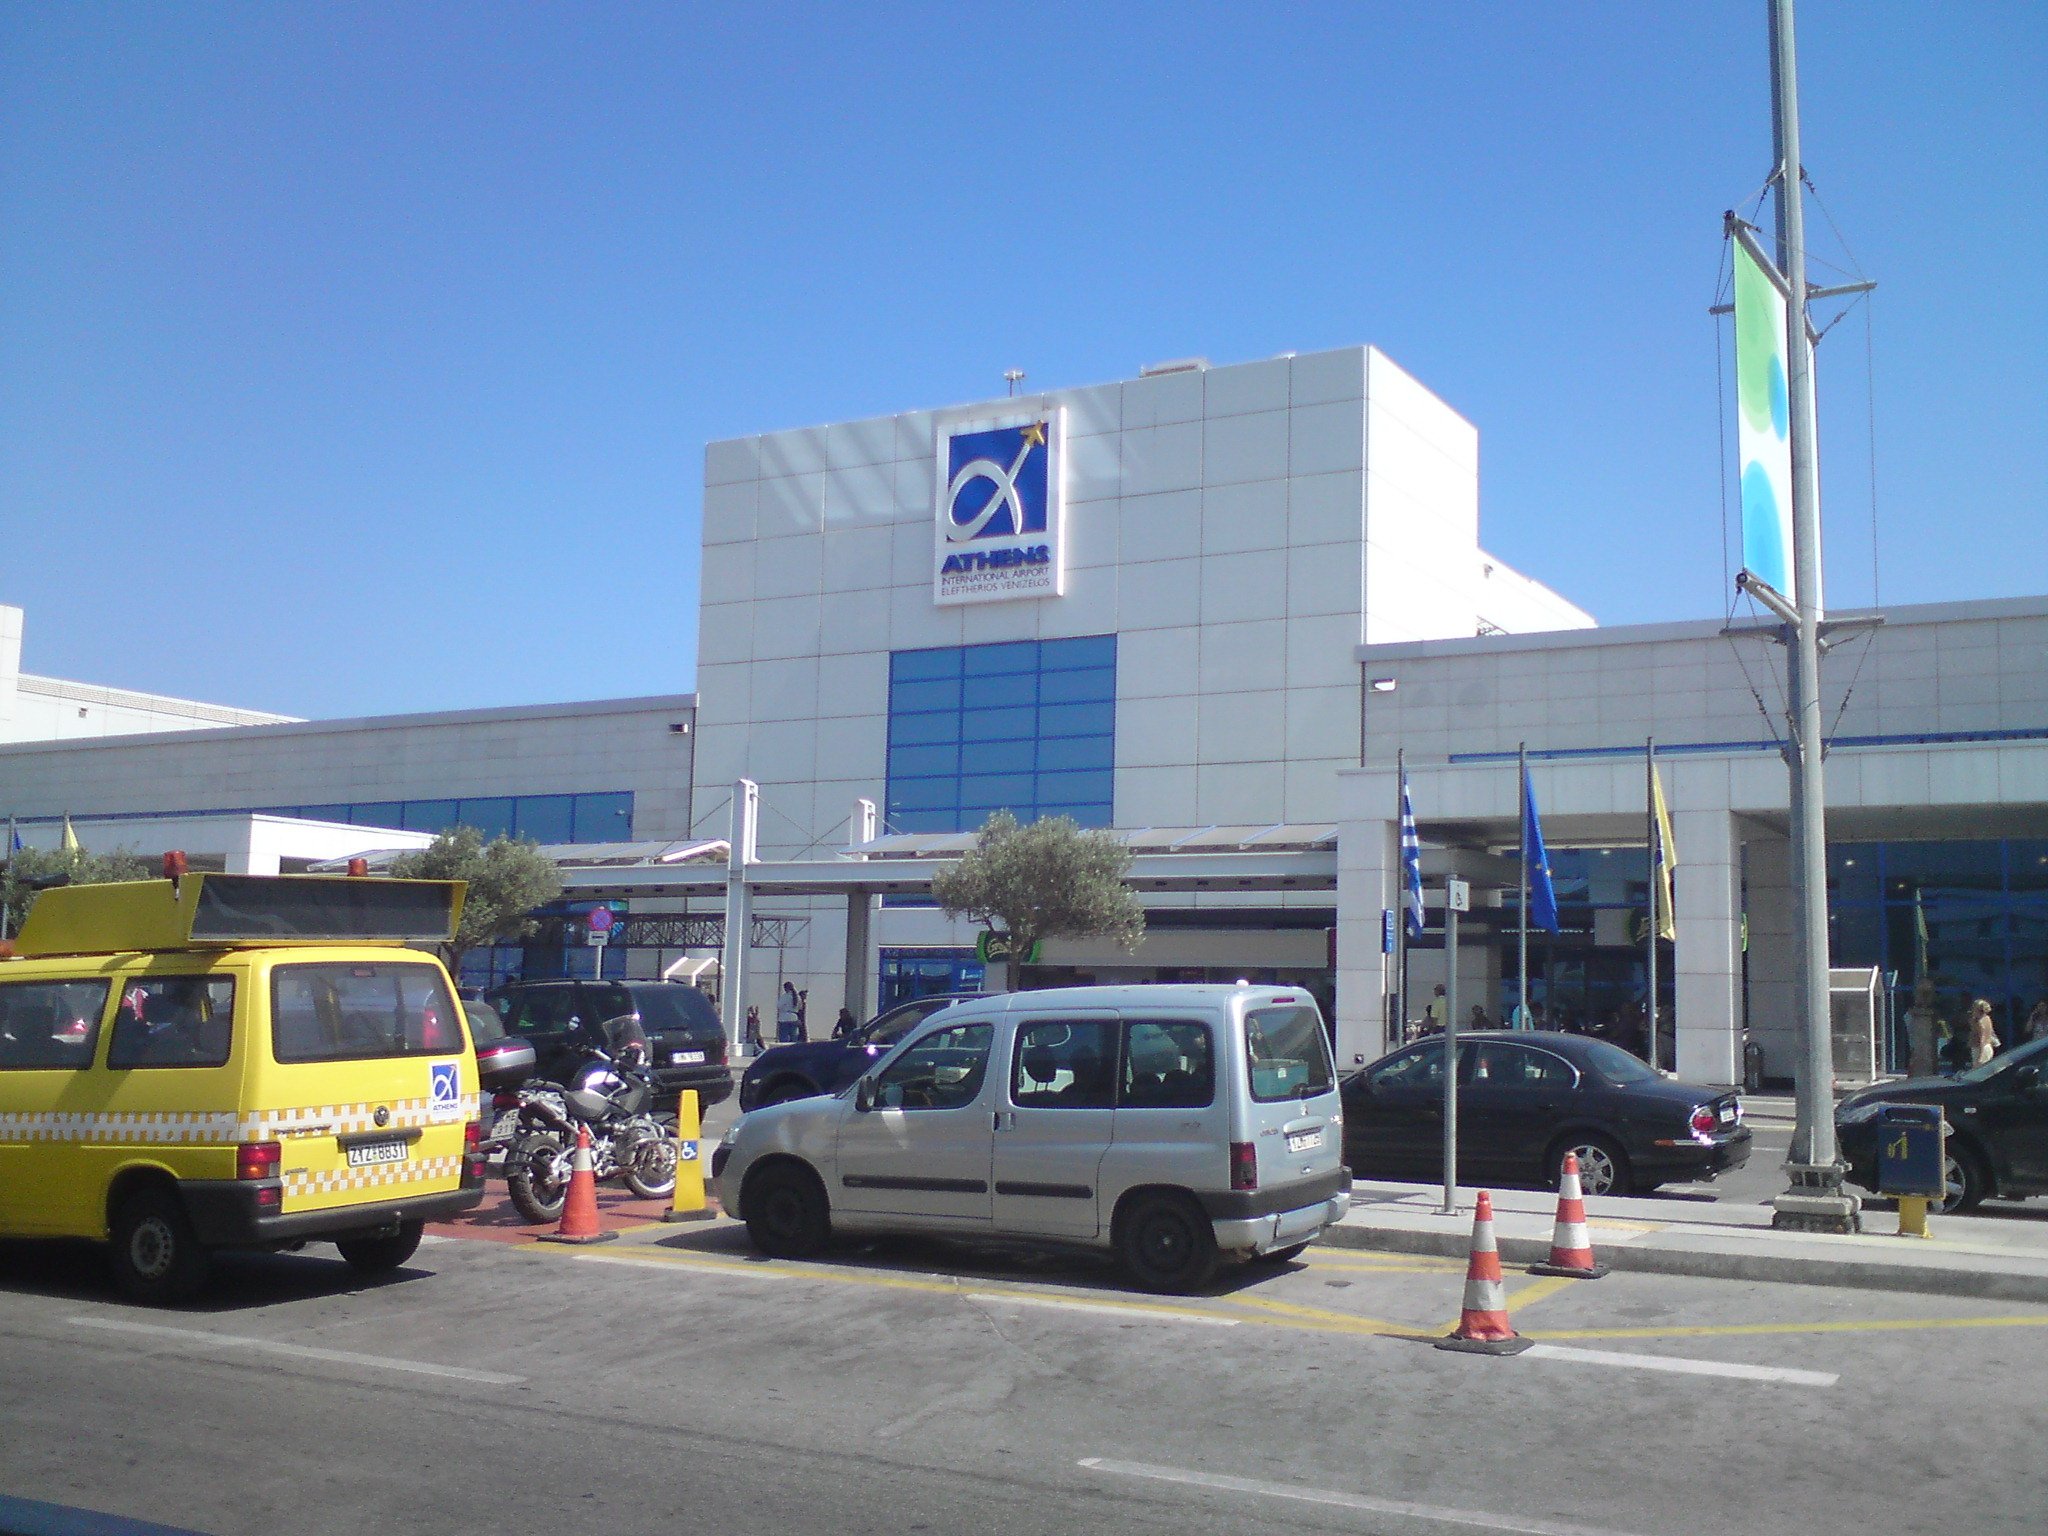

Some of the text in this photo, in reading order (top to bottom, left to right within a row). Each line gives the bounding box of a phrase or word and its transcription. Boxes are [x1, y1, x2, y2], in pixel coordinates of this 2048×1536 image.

[941, 545, 1050, 574] ATHENS
[942, 567, 1049, 586] INTERNATIONAL AIRPORT
[941, 578, 1050, 596] ELEFTHERIOS VENIZELOS
